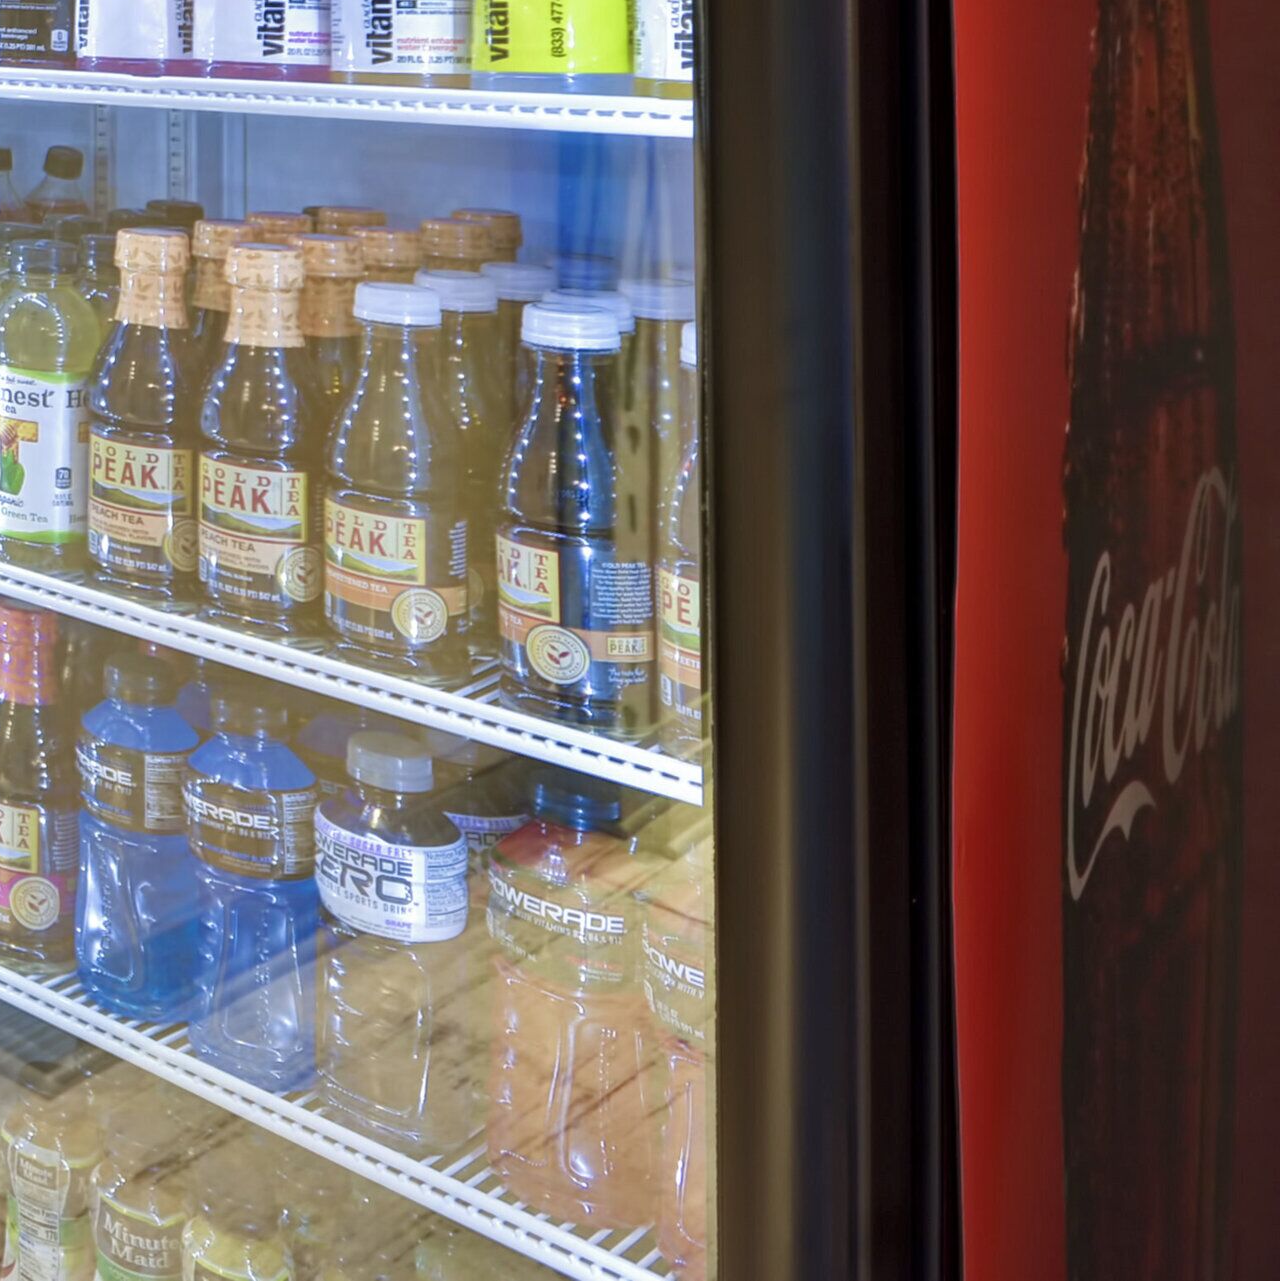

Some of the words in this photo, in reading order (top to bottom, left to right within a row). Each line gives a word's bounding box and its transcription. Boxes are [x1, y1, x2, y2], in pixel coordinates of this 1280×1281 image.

[551, 26, 567, 58] (833)
[93, 441, 159, 464] GOLD
[93, 453, 159, 490] PEAK
[173, 454, 186, 490] TEA
[202, 462, 272, 488] GOLD
[202, 475, 272, 515] PEAK
[287, 477, 301, 516] TEA
[1, 506, 29, 521] Green
[30, 513, 48, 523] Tea
[121, 513, 145, 526] TEA
[230, 539, 256, 553] TEA
[403, 523, 417, 560] TEA
[370, 583, 389, 594] TEA
[534, 553, 549, 594] TEA
[1067, 465, 1240, 901] Coca-Cola
[17, 813, 31, 849] TEA
[349, 836, 381, 855] SUGAR
[315, 830, 413, 877] OWERADE
[344, 890, 378, 909] SPORTS
[488, 870, 625, 934] POWERADE
[385, 920, 412, 929] GRAPE
[534, 916, 571, 936] VITAMINS
[104, 1214, 179, 1250] Minute
[111, 1238, 169, 1268] Maid
